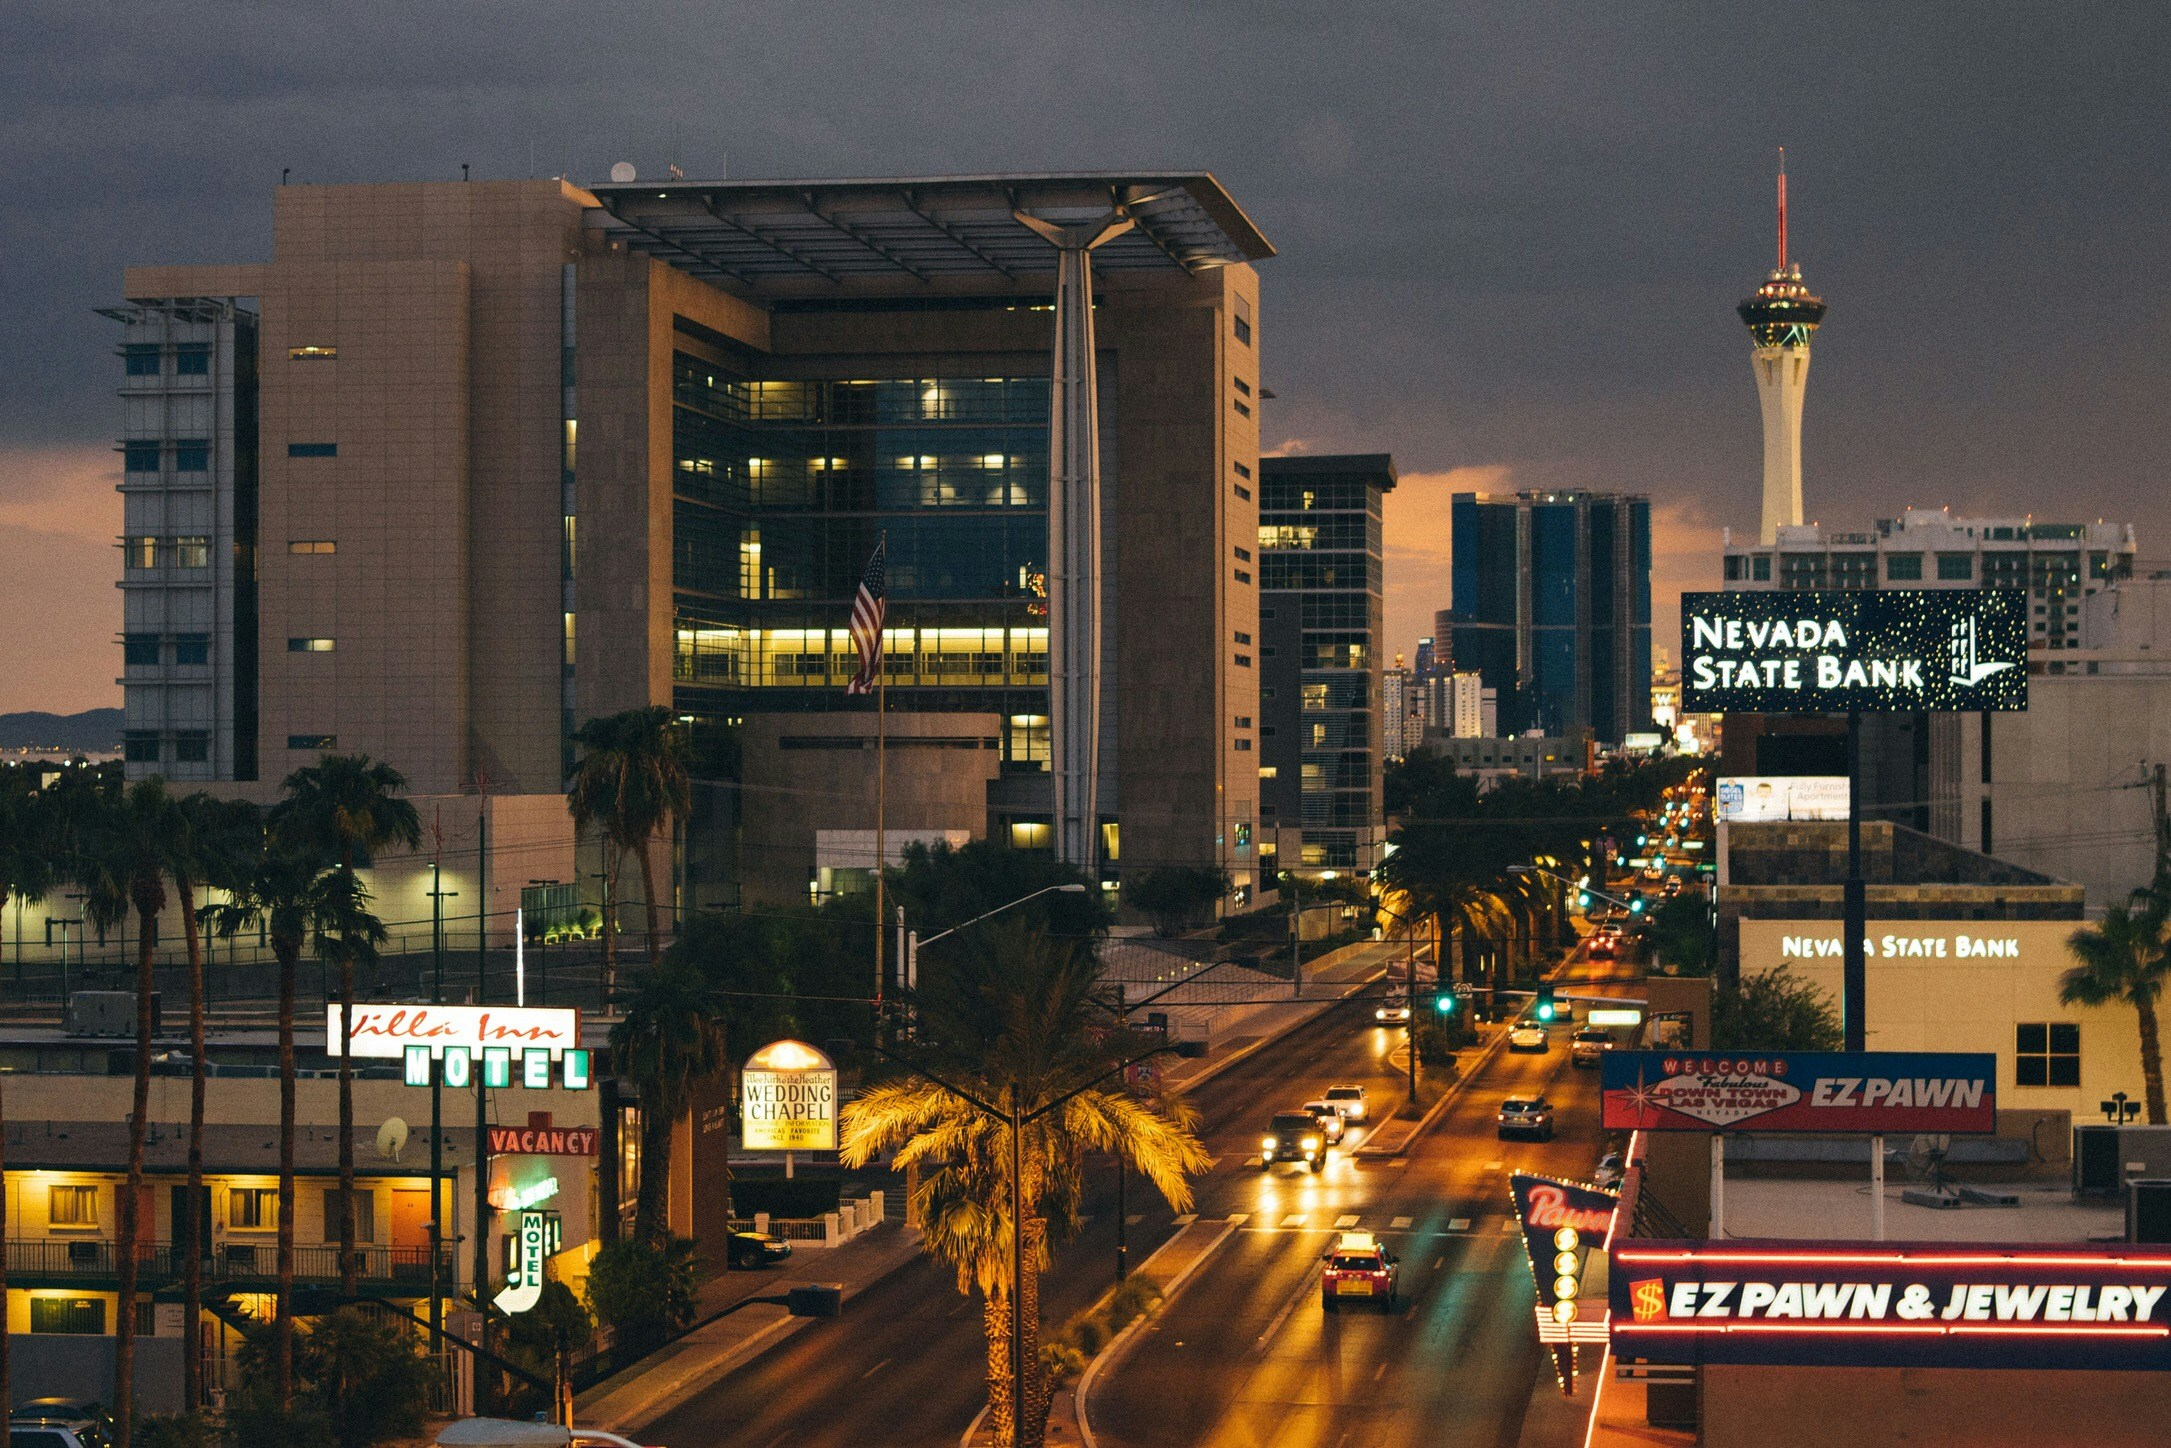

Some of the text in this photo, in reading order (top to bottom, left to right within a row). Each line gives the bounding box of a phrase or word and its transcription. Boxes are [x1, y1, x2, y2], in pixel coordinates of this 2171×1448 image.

[1693, 617, 1848, 649] NEVADA
[1693, 655, 1925, 690] STATE BANK
[1782, 935, 2019, 958] NEVAA STATE BANK
[478, 1013, 563, 1042] Inn
[405, 1048, 588, 1088] MOTEL
[1663, 1059, 1784, 1075] WELCOME
[1697, 1075, 1769, 1088] Fabulous
[747, 1085, 831, 1102] WEDDING
[1660, 1088, 1787, 1099] DOWN TOWN
[1667, 1098, 1779, 1108] LAS VEGAS
[751, 1103, 830, 1120] CHAPEL
[1696, 1109, 1750, 1117] NEVADA
[491, 1130, 593, 1154] VACANCY
[1528, 1184, 1611, 1229] Pawn
[523, 1216, 541, 1287] MOTEL
[1941, 1284, 2168, 1322] JEWELRY
